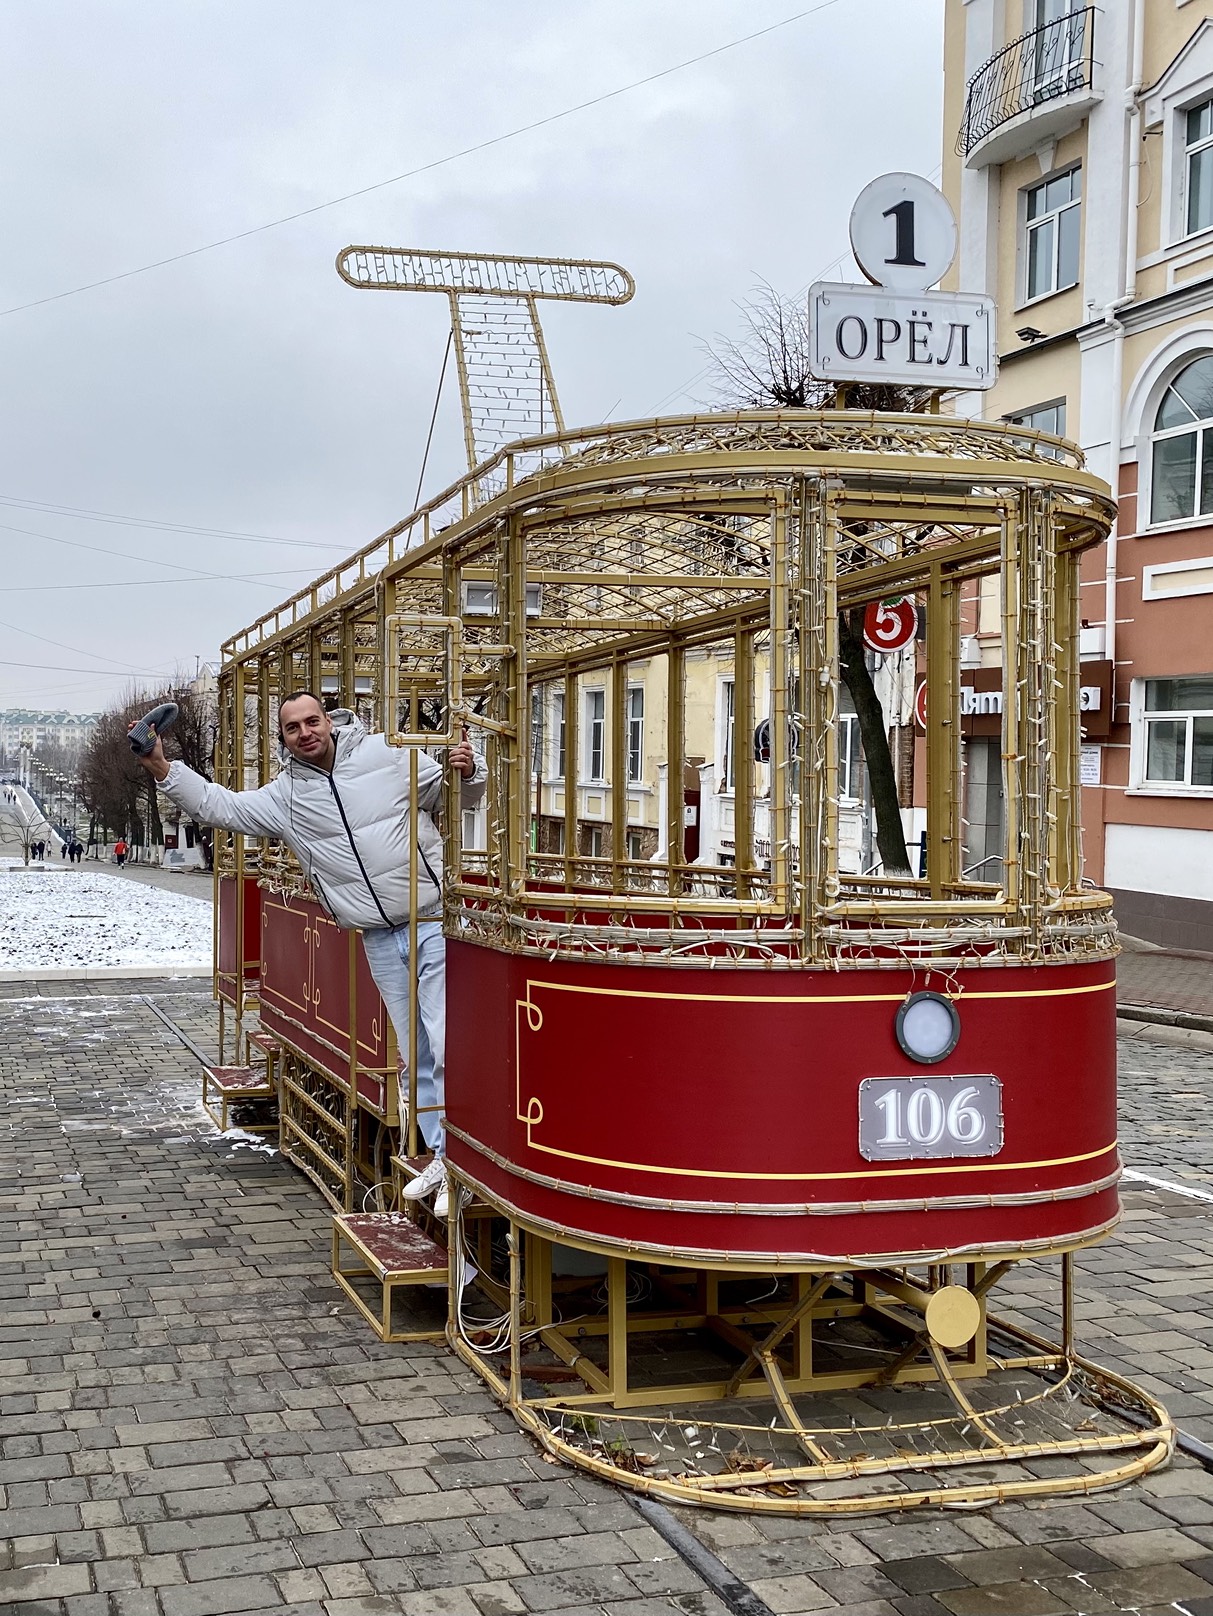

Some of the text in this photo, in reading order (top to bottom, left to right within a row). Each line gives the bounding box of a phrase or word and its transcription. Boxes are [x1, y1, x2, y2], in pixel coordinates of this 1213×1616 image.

[882, 200, 926, 267] 1
[835, 310, 970, 367] ОРЁЛ
[875, 597, 903, 641] 5
[874, 1086, 986, 1148] 106
